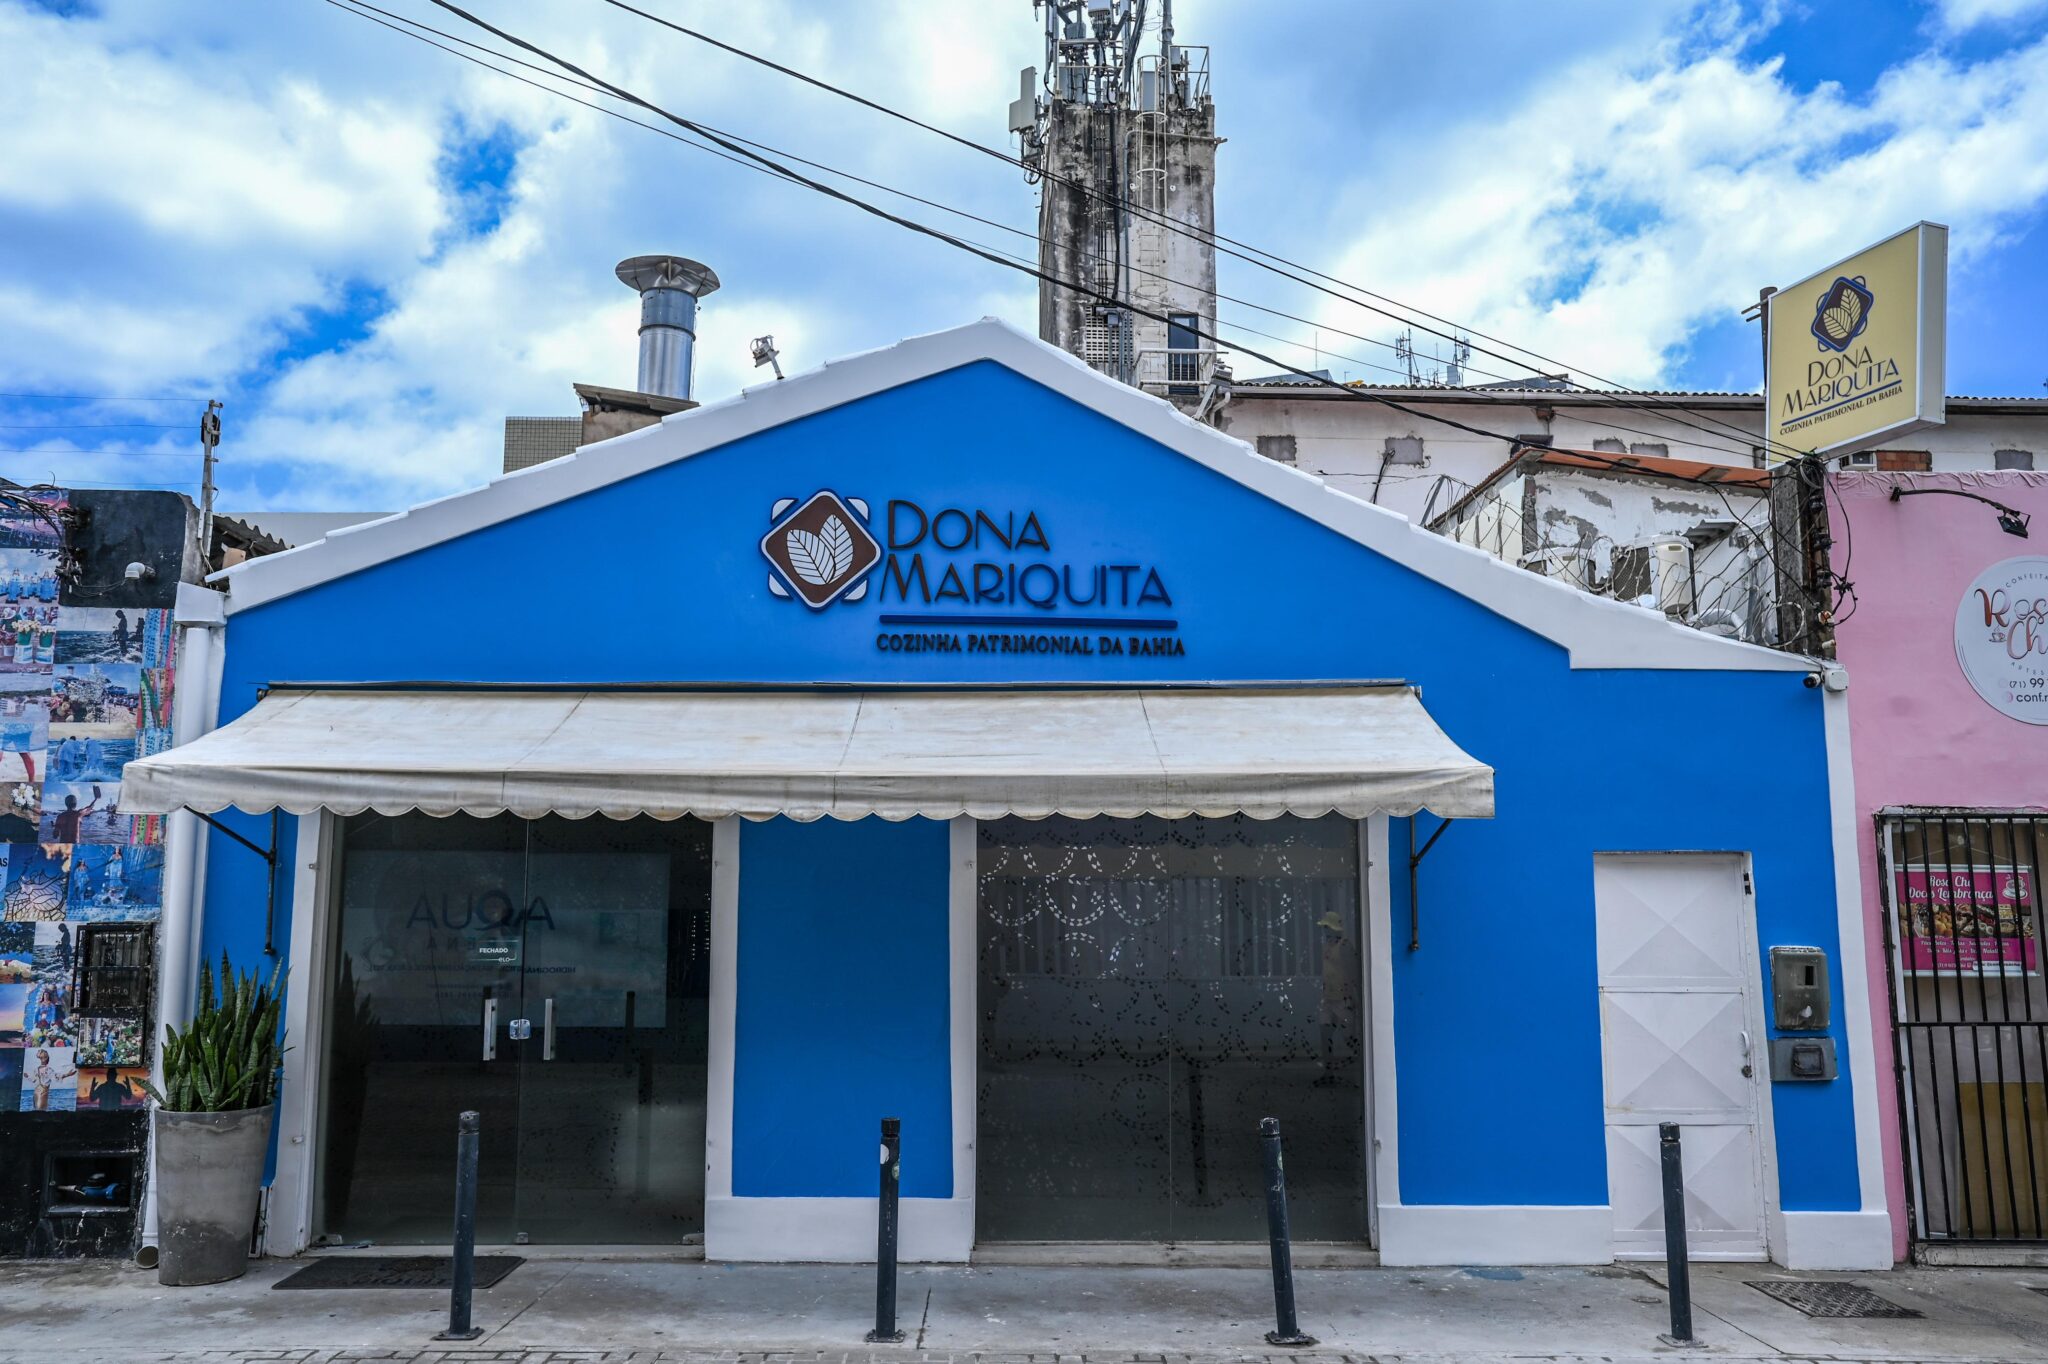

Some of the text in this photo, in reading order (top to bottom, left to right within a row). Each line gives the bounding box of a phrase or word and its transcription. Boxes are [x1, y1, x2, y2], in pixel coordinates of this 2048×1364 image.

[1782, 357, 1899, 417] MARIQUITA
[1807, 345, 1873, 387] DONA
[1779, 385, 1903, 436] COZINHA PATRIMONIAL DA BAHIA
[887, 499, 1050, 552] DONA
[879, 553, 1173, 609] MARIQUITA
[875, 632, 1185, 656] COZINHA PATRIMONIAL DA BAHIA
